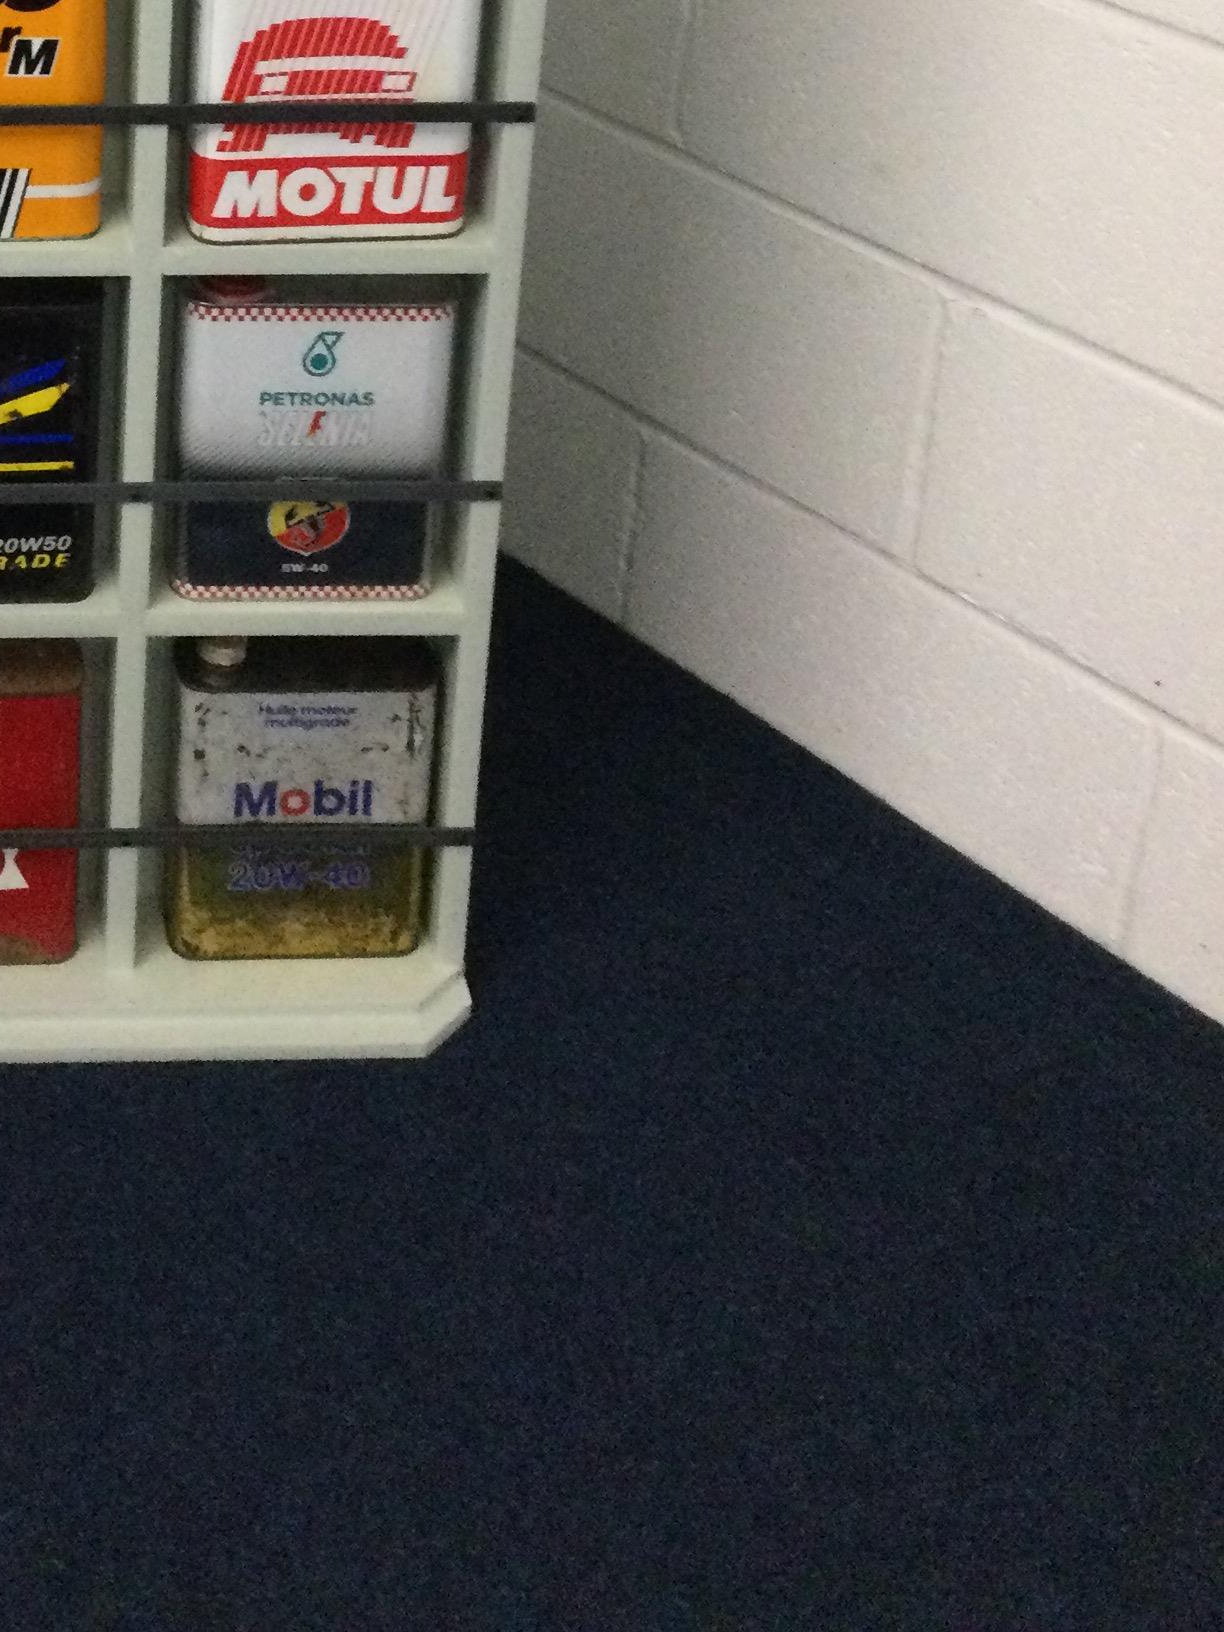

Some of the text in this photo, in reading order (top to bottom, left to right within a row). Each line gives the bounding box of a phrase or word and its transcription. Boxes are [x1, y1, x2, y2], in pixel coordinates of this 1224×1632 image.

[7, 38, 60, 76] M
[211, 165, 456, 218] MOTUL
[258, 391, 375, 407] PETRONAS
[233, 779, 374, 818] Mobil
